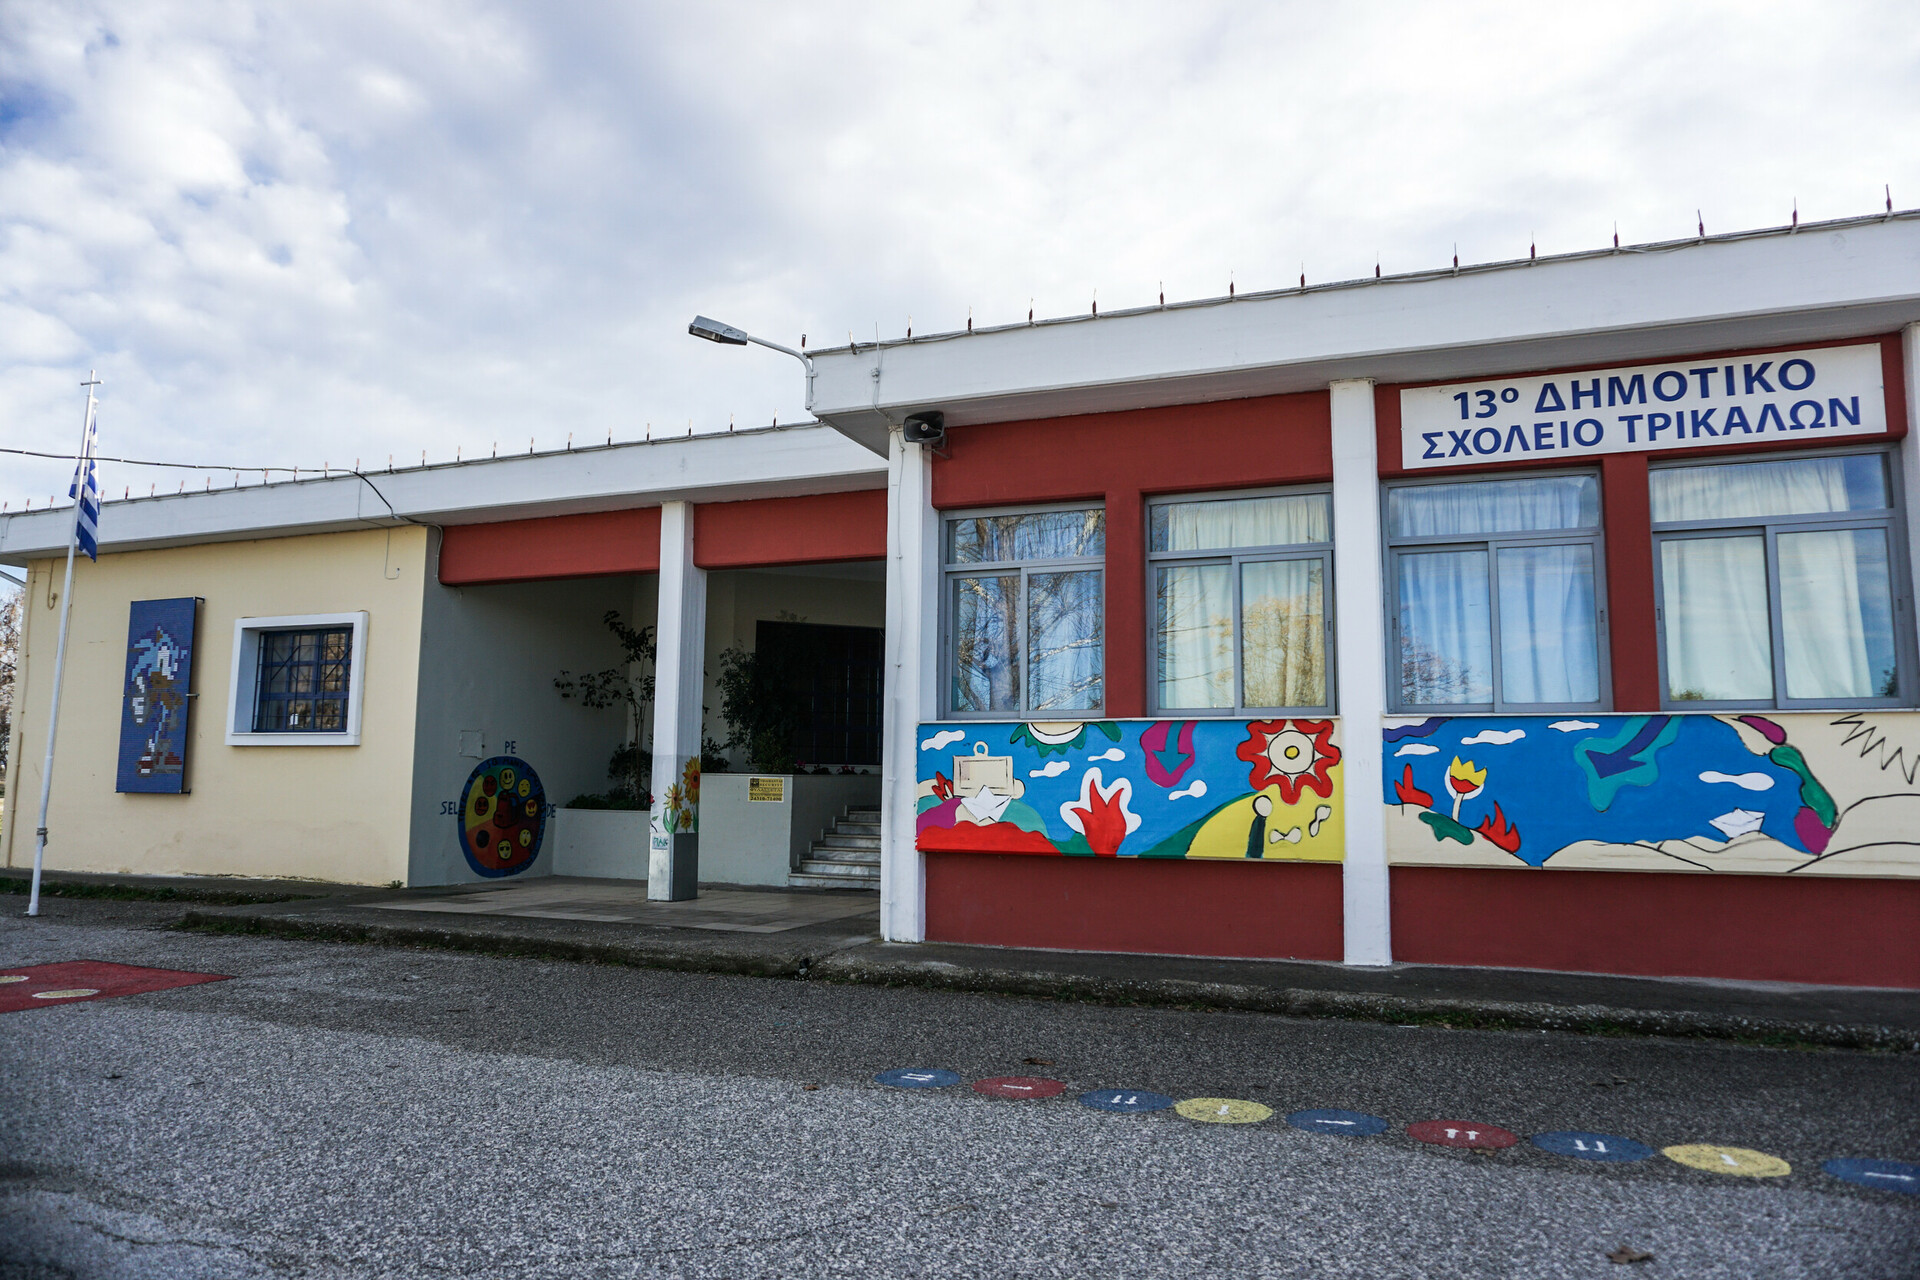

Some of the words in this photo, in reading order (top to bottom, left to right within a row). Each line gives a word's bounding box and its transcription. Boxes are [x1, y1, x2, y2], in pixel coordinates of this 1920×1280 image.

[1534, 358, 1816, 413] ΔΗΜΟΤΙΚΟ
[1421, 418, 1604, 460] ΣΧΟΛΕΙΟ
[1618, 396, 1862, 443] ΤΡΙΚΑΛΩΝ
